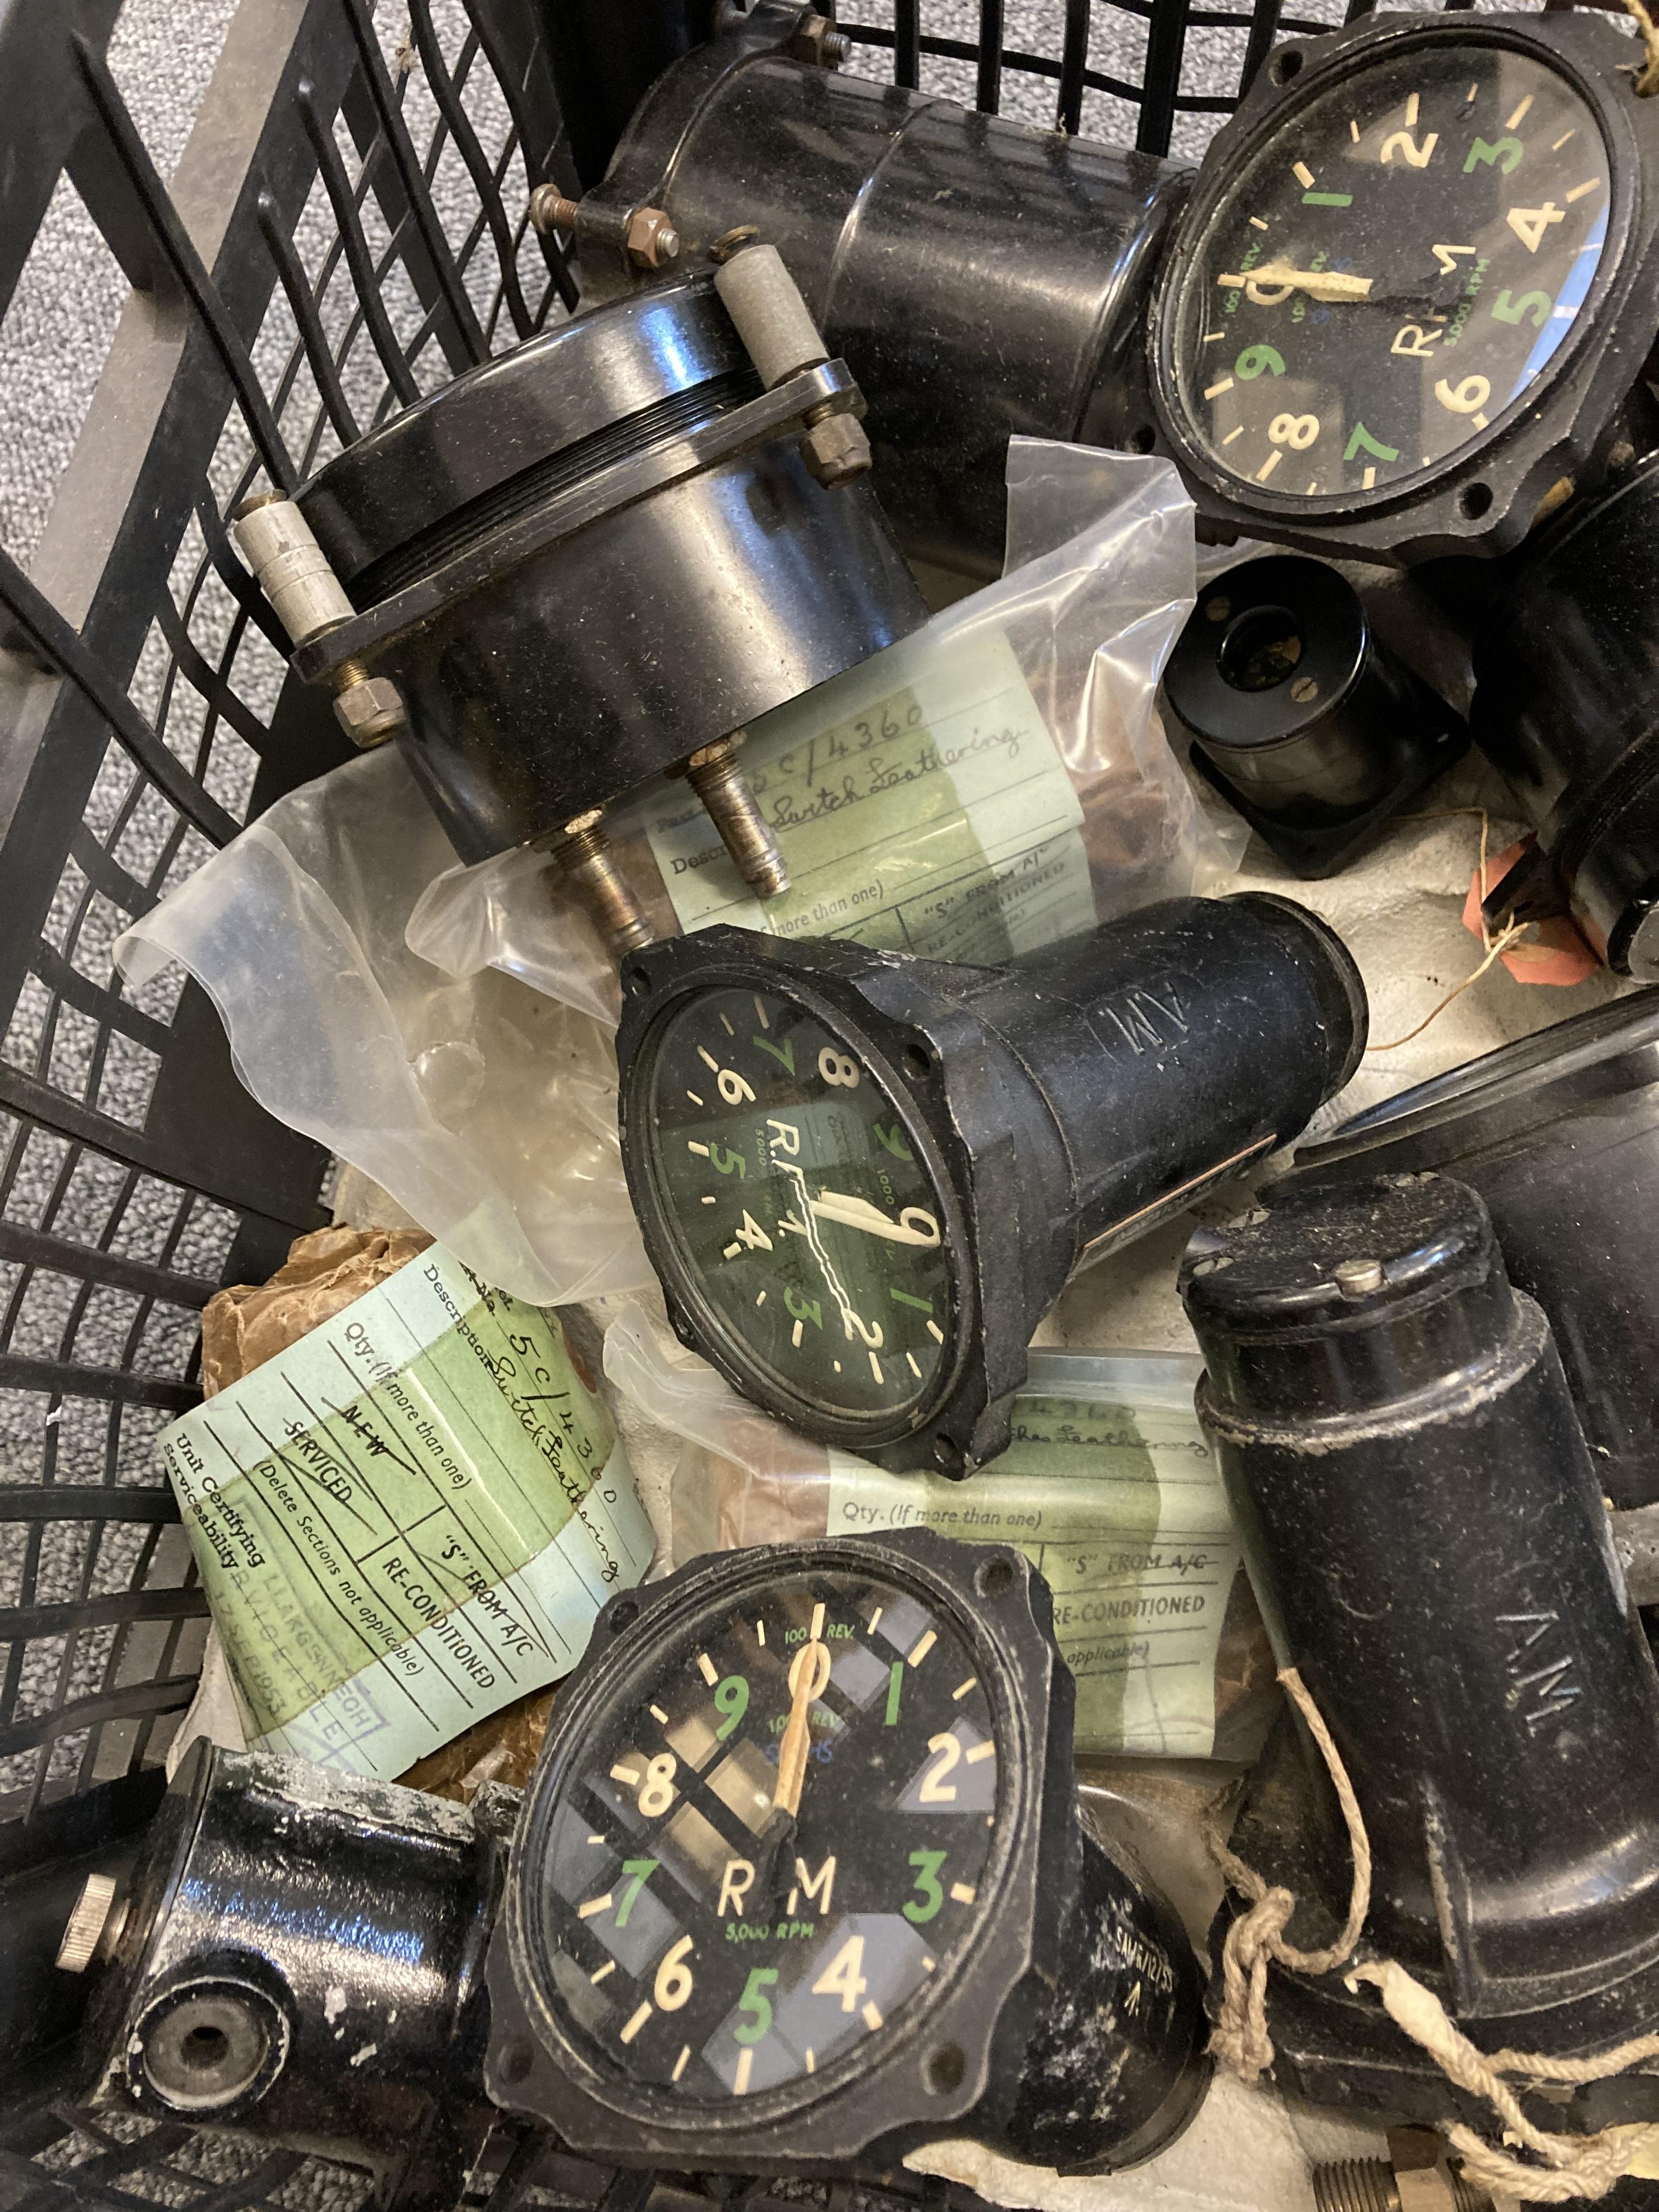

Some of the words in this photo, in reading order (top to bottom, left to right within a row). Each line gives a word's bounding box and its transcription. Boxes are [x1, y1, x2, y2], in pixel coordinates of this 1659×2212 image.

[1381, 132, 1439, 168] 2
[1463, 137, 1523, 174] 3
[1506, 202, 1566, 254] 4
[1492, 290, 1551, 327] 5
[1235, 345, 1285, 381] 9
[1435, 375, 1491, 414] 6
[1268, 414, 1319, 450] 8
[1343, 421, 1400, 462] 7
[812, 895, 849, 926] than
[753, 1035, 795, 1076] 7
[817, 1046, 860, 1088] 8
[710, 1142, 746, 1179] 5
[877, 1169, 895, 1205] 1000
[735, 1209, 773, 1252] 4
[424, 1264, 496, 1369] Description
[783, 1286, 823, 1330] 3
[345, 1323, 374, 1363] Qty.
[386, 1384, 418, 1421] more
[416, 1421, 444, 1456] than
[442, 1458, 472, 1489] one)
[285, 1422, 352, 1505] SERVICED
[164, 1443, 239, 1568] Serviceability
[177, 1433, 204, 1474] Unit
[202, 1477, 265, 1567] Certifying
[843, 1502, 884, 1523] Qty.
[890, 1503, 913, 1525] (If
[915, 1510, 958, 1524] more
[964, 1507, 1000, 1525] than
[1007, 1510, 1042, 1531] one)
[253, 1459, 297, 1512] (Delete
[297, 1516, 340, 1575] Sections
[339, 1581, 362, 1605] not
[359, 1608, 424, 1675] applicable)
[382, 1557, 495, 1688] RE-CONDITIONED
[461, 1570, 508, 1620] FROM
[500, 1620, 533, 1656] A/C
[1053, 1595, 1205, 1626] RE-CONDITIONED
[785, 1626, 808, 1644] 100
[714, 1675, 750, 1741] 9
[885, 1661, 903, 1726] 1
[637, 1752, 677, 1818] 8
[918, 1731, 961, 1803] 2
[615, 1859, 659, 1928] 7
[902, 1850, 947, 1923] 3
[776, 1922, 815, 1940] RPM
[654, 1934, 695, 2012] 6
[812, 1935, 867, 2012] 4
[733, 1968, 780, 2045] 5
